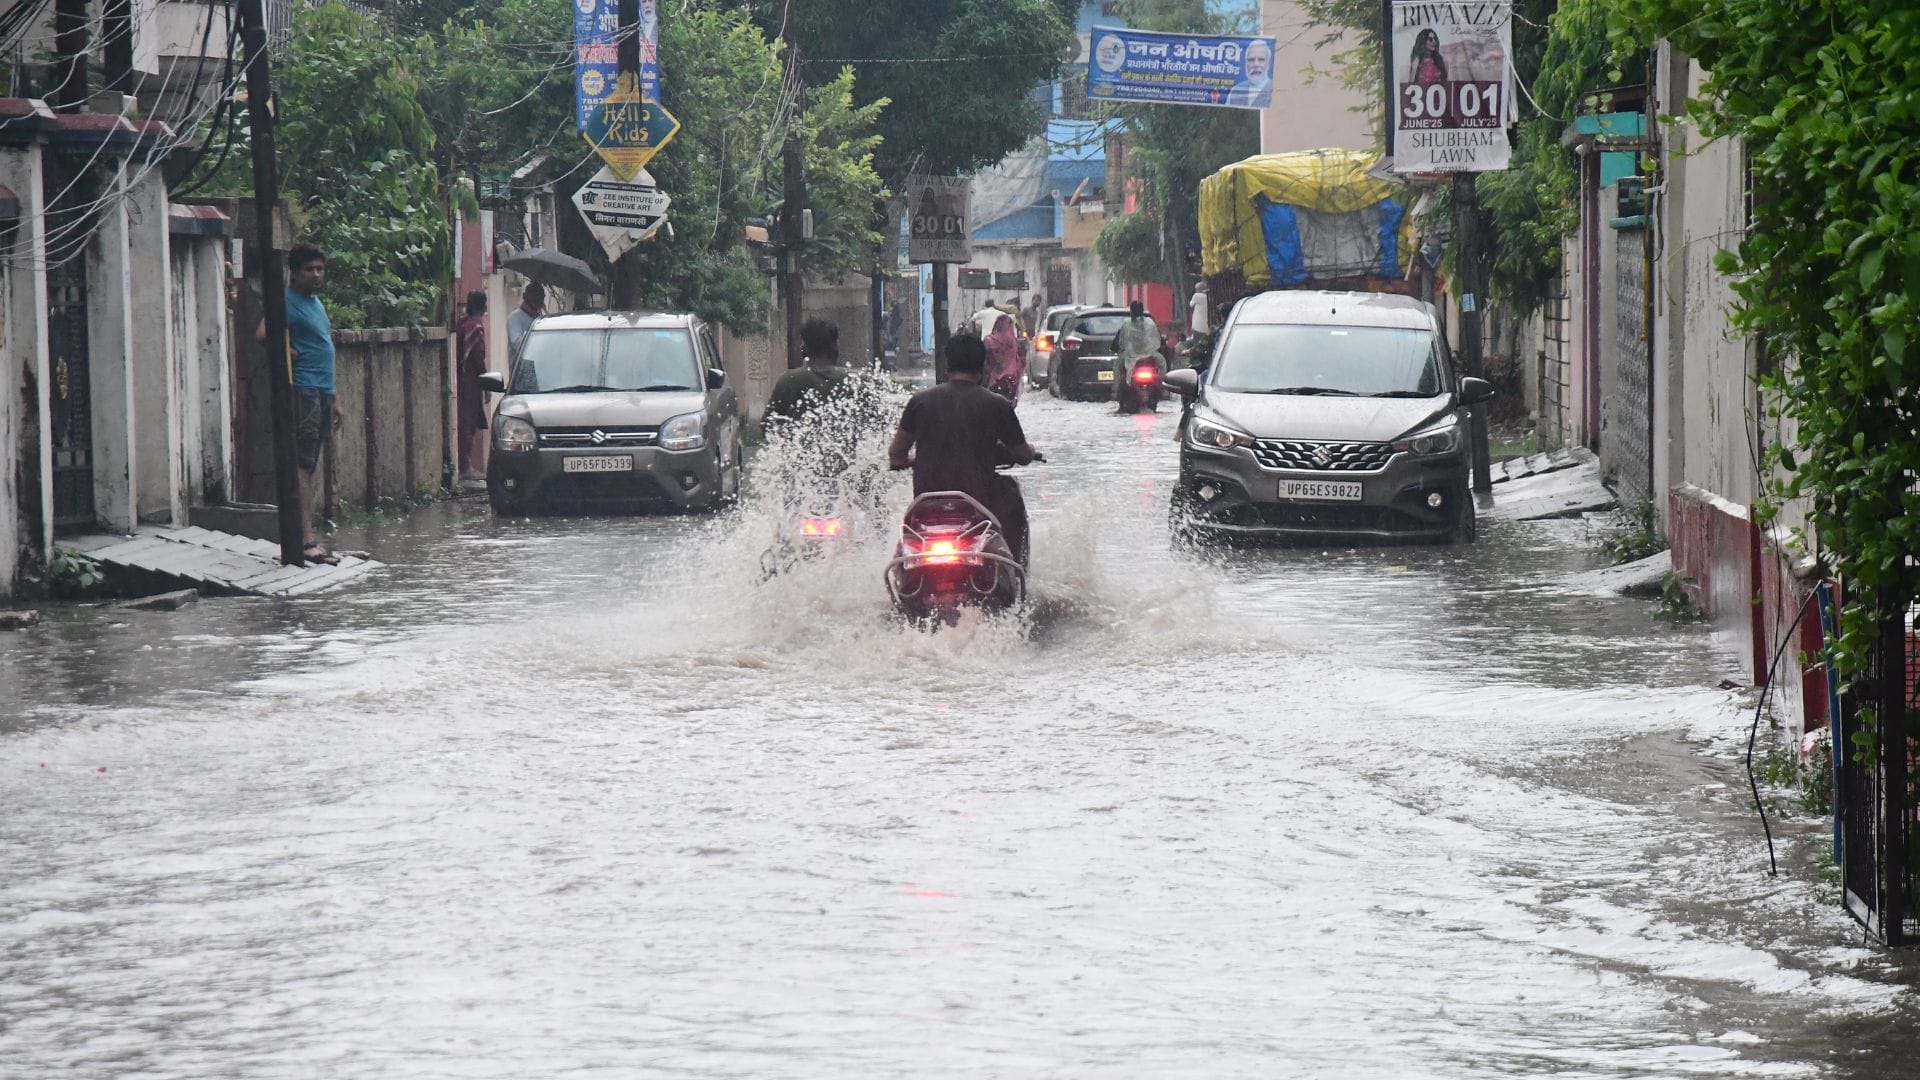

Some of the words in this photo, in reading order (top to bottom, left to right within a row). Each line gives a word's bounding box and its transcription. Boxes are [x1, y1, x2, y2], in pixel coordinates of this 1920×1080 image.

[1127, 40, 1169, 57] जन
[1173, 40, 1242, 62] औषधि
[1403, 84, 1447, 118] 30
[1459, 83, 1498, 117] 01
[603, 104, 650, 124] Hello
[1403, 119, 1443, 129] JUNE'25
[1461, 118, 1497, 127] JULY'25
[609, 122, 649, 144] Kids
[1412, 131, 1493, 149] SHUBHAM
[1431, 148, 1476, 164] LAWN
[603, 201, 636, 210] CREATIVE
[617, 194, 653, 204] INSTITUTE
[654, 197, 664, 205] OF
[914, 215, 939, 234] 30
[943, 216, 965, 234] 01
[570, 458, 632, 470] UP65FD5399
[1287, 483, 1360, 497] UP65ES9822
